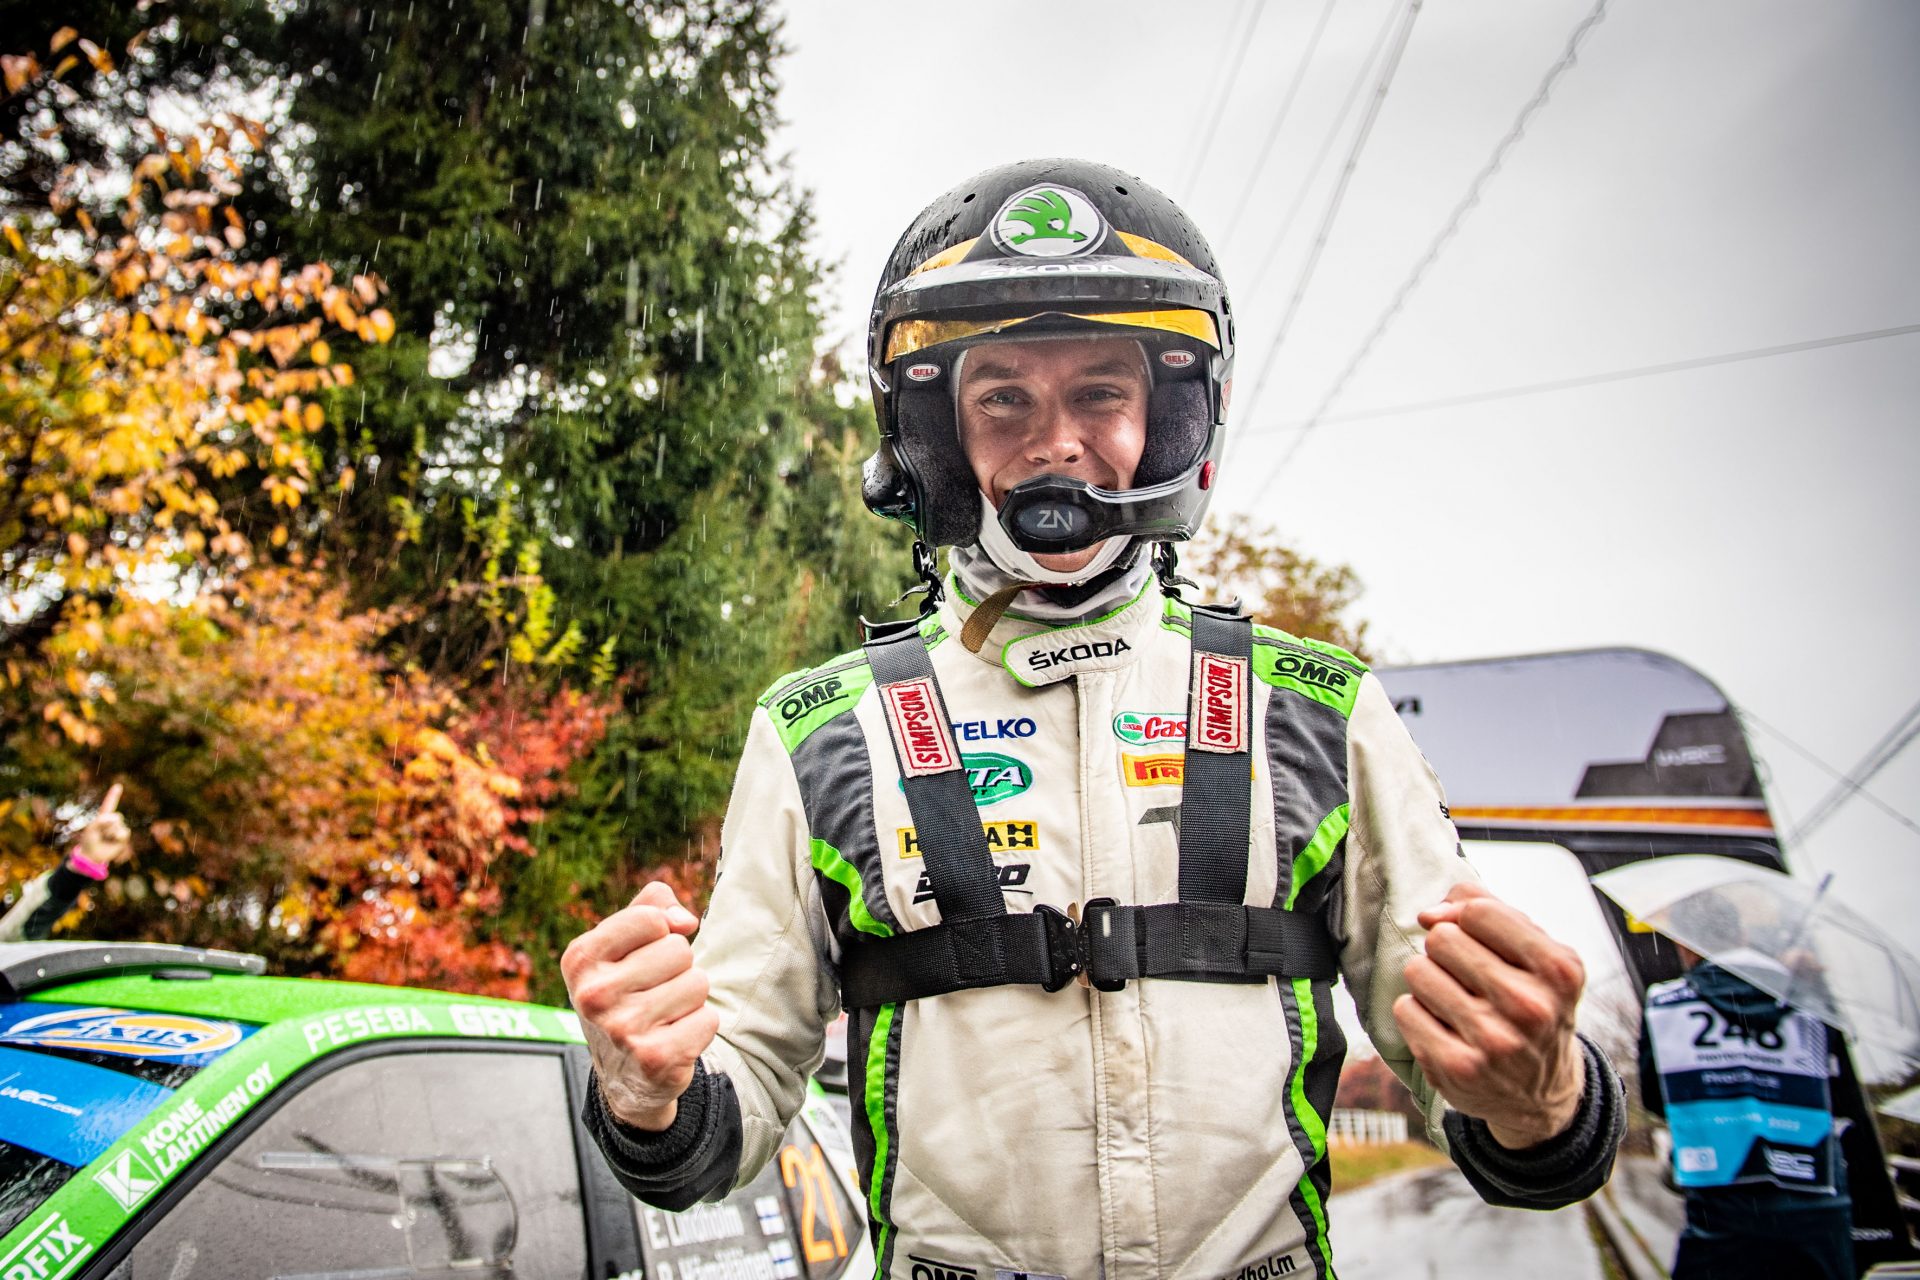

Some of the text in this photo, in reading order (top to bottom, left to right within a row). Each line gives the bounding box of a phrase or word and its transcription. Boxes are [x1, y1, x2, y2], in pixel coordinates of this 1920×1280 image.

[912, 368, 935, 376] BELL
[1028, 637, 1132, 671] ŠKODA
[1274, 656, 1348, 687] OMP
[781, 679, 842, 720] OMP
[896, 688, 943, 765] SIMPSON
[1206, 663, 1233, 744] SIMPSON
[302, 1005, 433, 1055] PESEBA
[139, 1096, 206, 1156] KONE
[153, 1061, 276, 1178] LAHTINEN OY
[780, 1144, 849, 1263] 21
